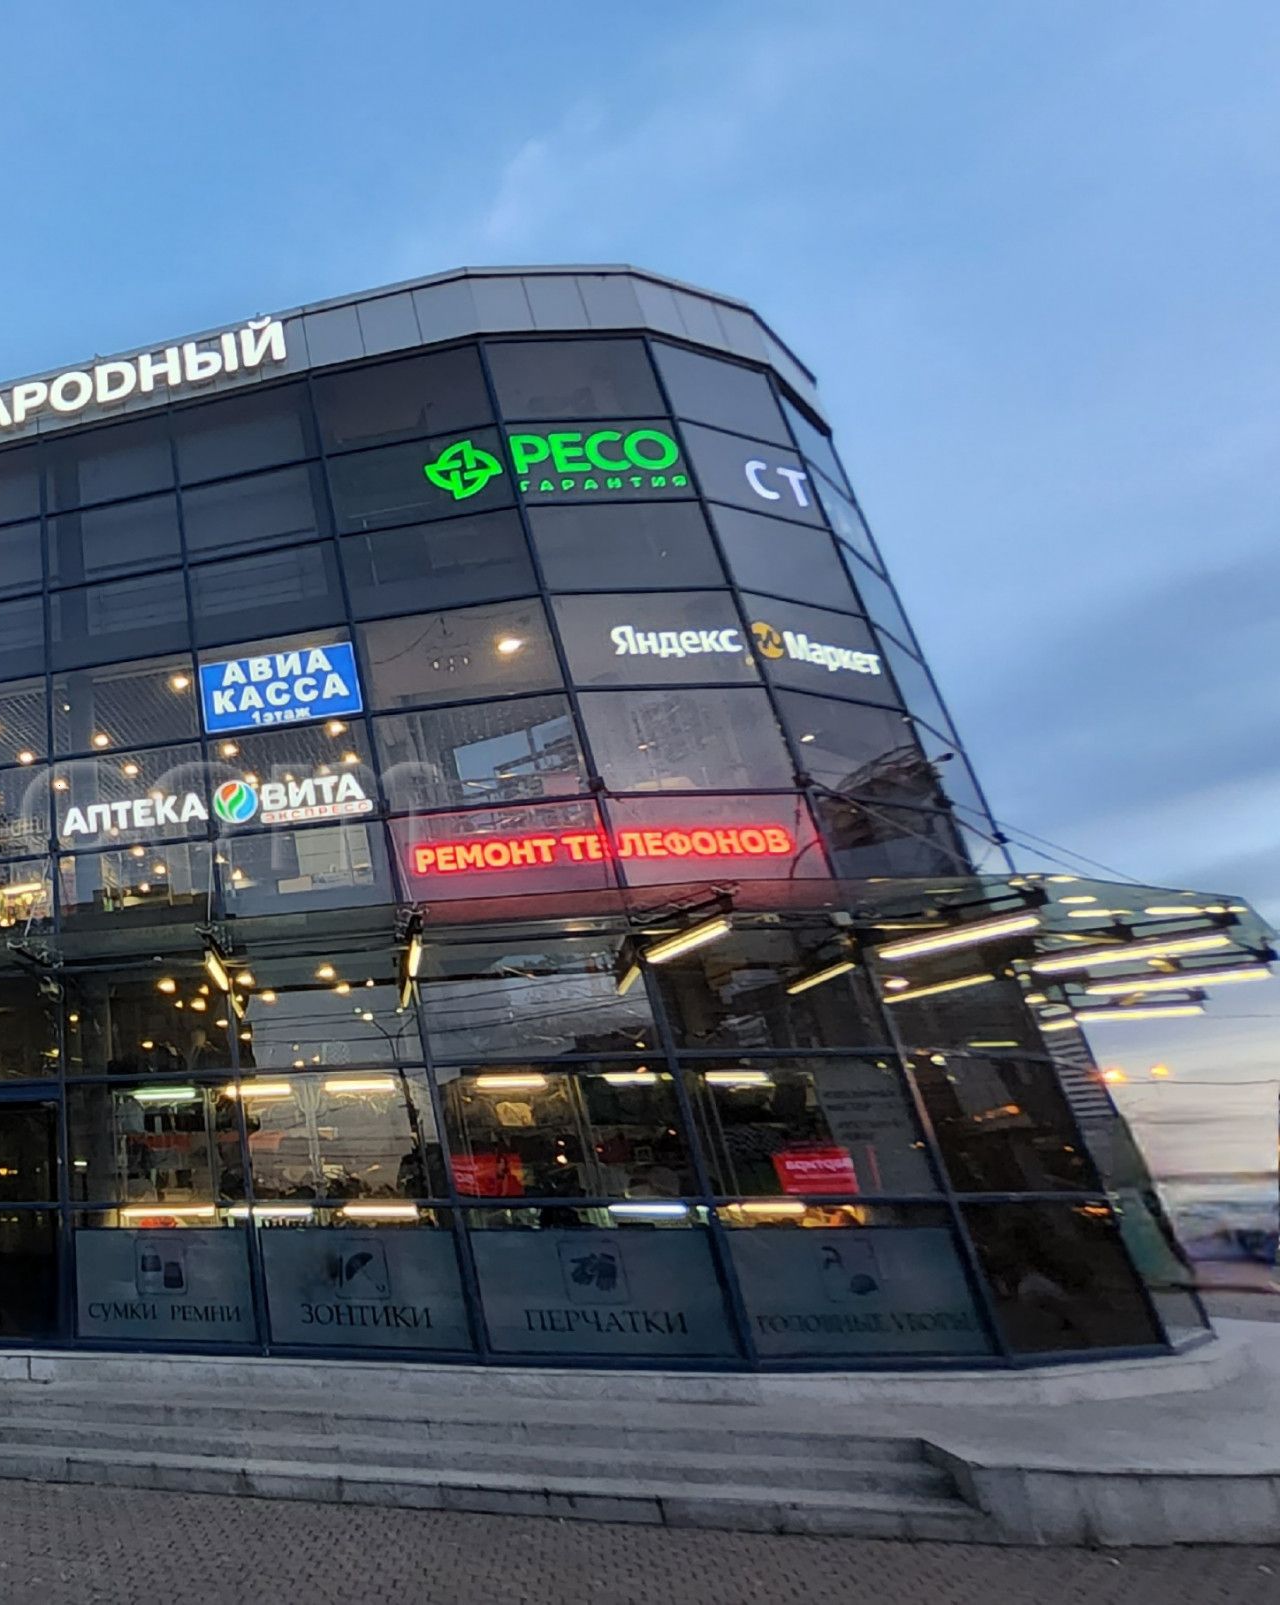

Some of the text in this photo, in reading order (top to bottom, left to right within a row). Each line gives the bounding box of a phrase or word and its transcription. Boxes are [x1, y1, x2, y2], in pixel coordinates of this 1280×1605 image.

[509, 430, 679, 473] РЕСО
[519, 475, 688, 492] ГАРАНТИЯ
[222, 648, 333, 687] АВИА
[610, 625, 881, 675] Яндекс Маркет
[211, 673, 350, 716] КАССА
[261, 772, 366, 811] ВИТА
[62, 793, 210, 837] АПТЕКА
[264, 801, 371, 823] ЭКСПРЕСС
[415, 828, 792, 873] РЕМОНТ ТЕЛЕФОНОВ
[88, 1302, 241, 1323] СУМКИ РЕМНИ
[300, 1302, 433, 1329] ЗОНТИКИ
[524, 1308, 689, 1335] ПЕРЧАТКИ
